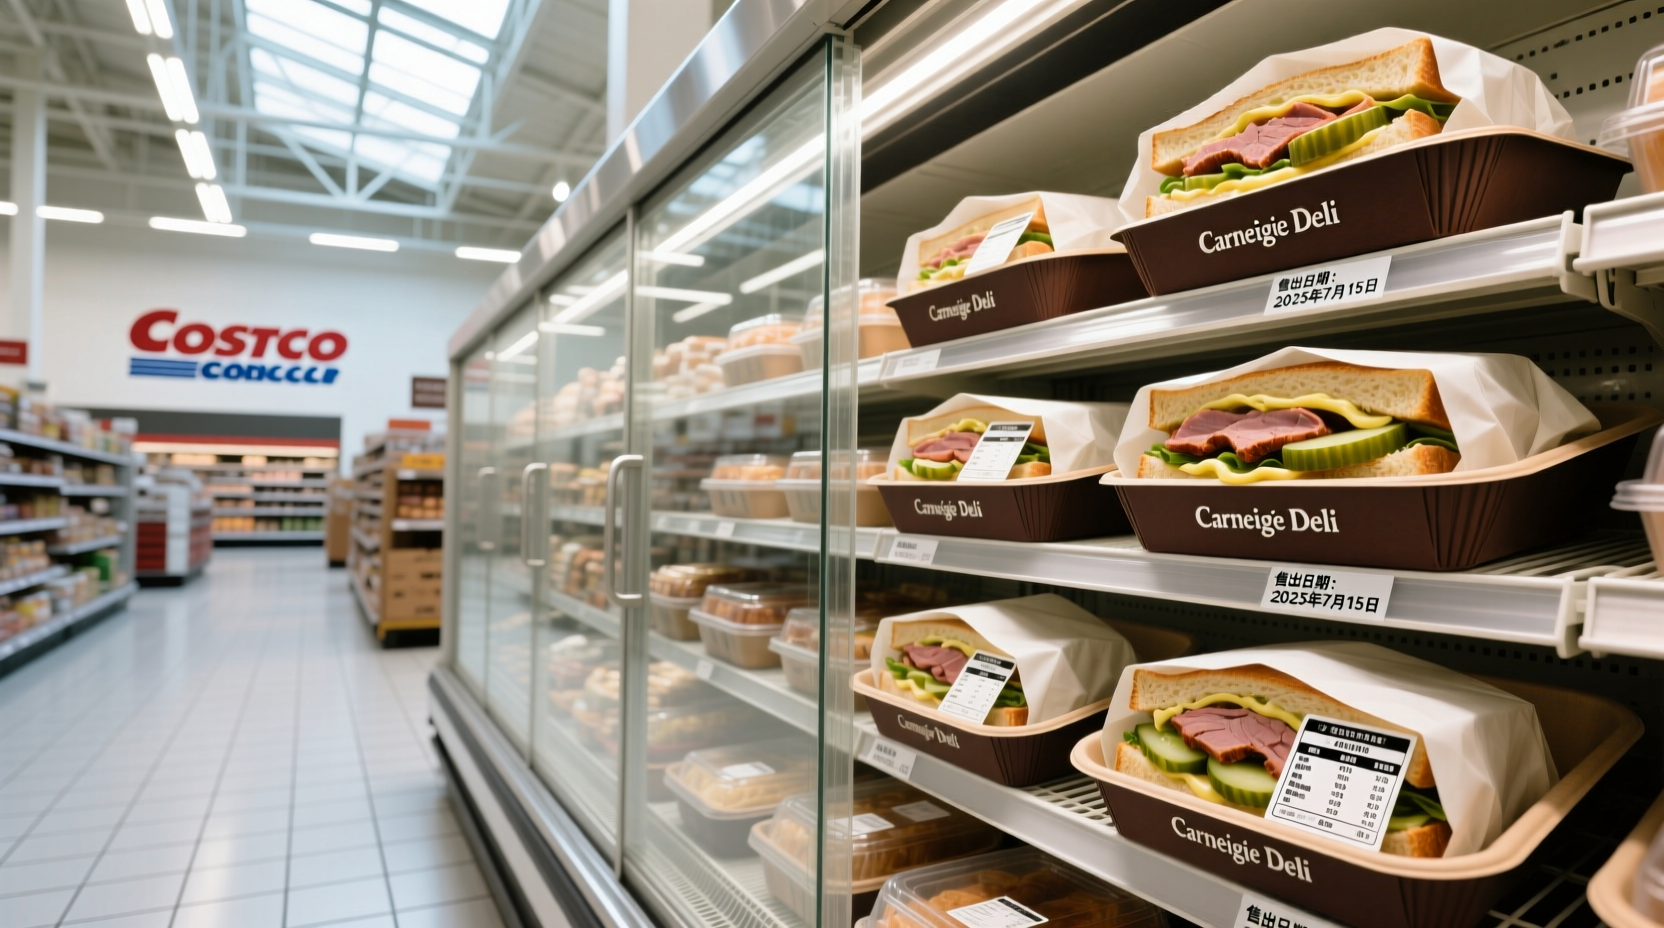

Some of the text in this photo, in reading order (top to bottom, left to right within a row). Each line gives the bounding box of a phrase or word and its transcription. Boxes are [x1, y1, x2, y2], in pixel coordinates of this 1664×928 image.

[1289, 199, 1341, 234] Deli
[1273, 277, 1379, 309] 2025年7月15日
[130, 310, 348, 361] COSTCO
[1288, 507, 1340, 533] Deli
[1269, 590, 1380, 614] 2025年7月15日
[1171, 816, 1261, 865] Carneigie
[1263, 846, 1313, 883] Deli
